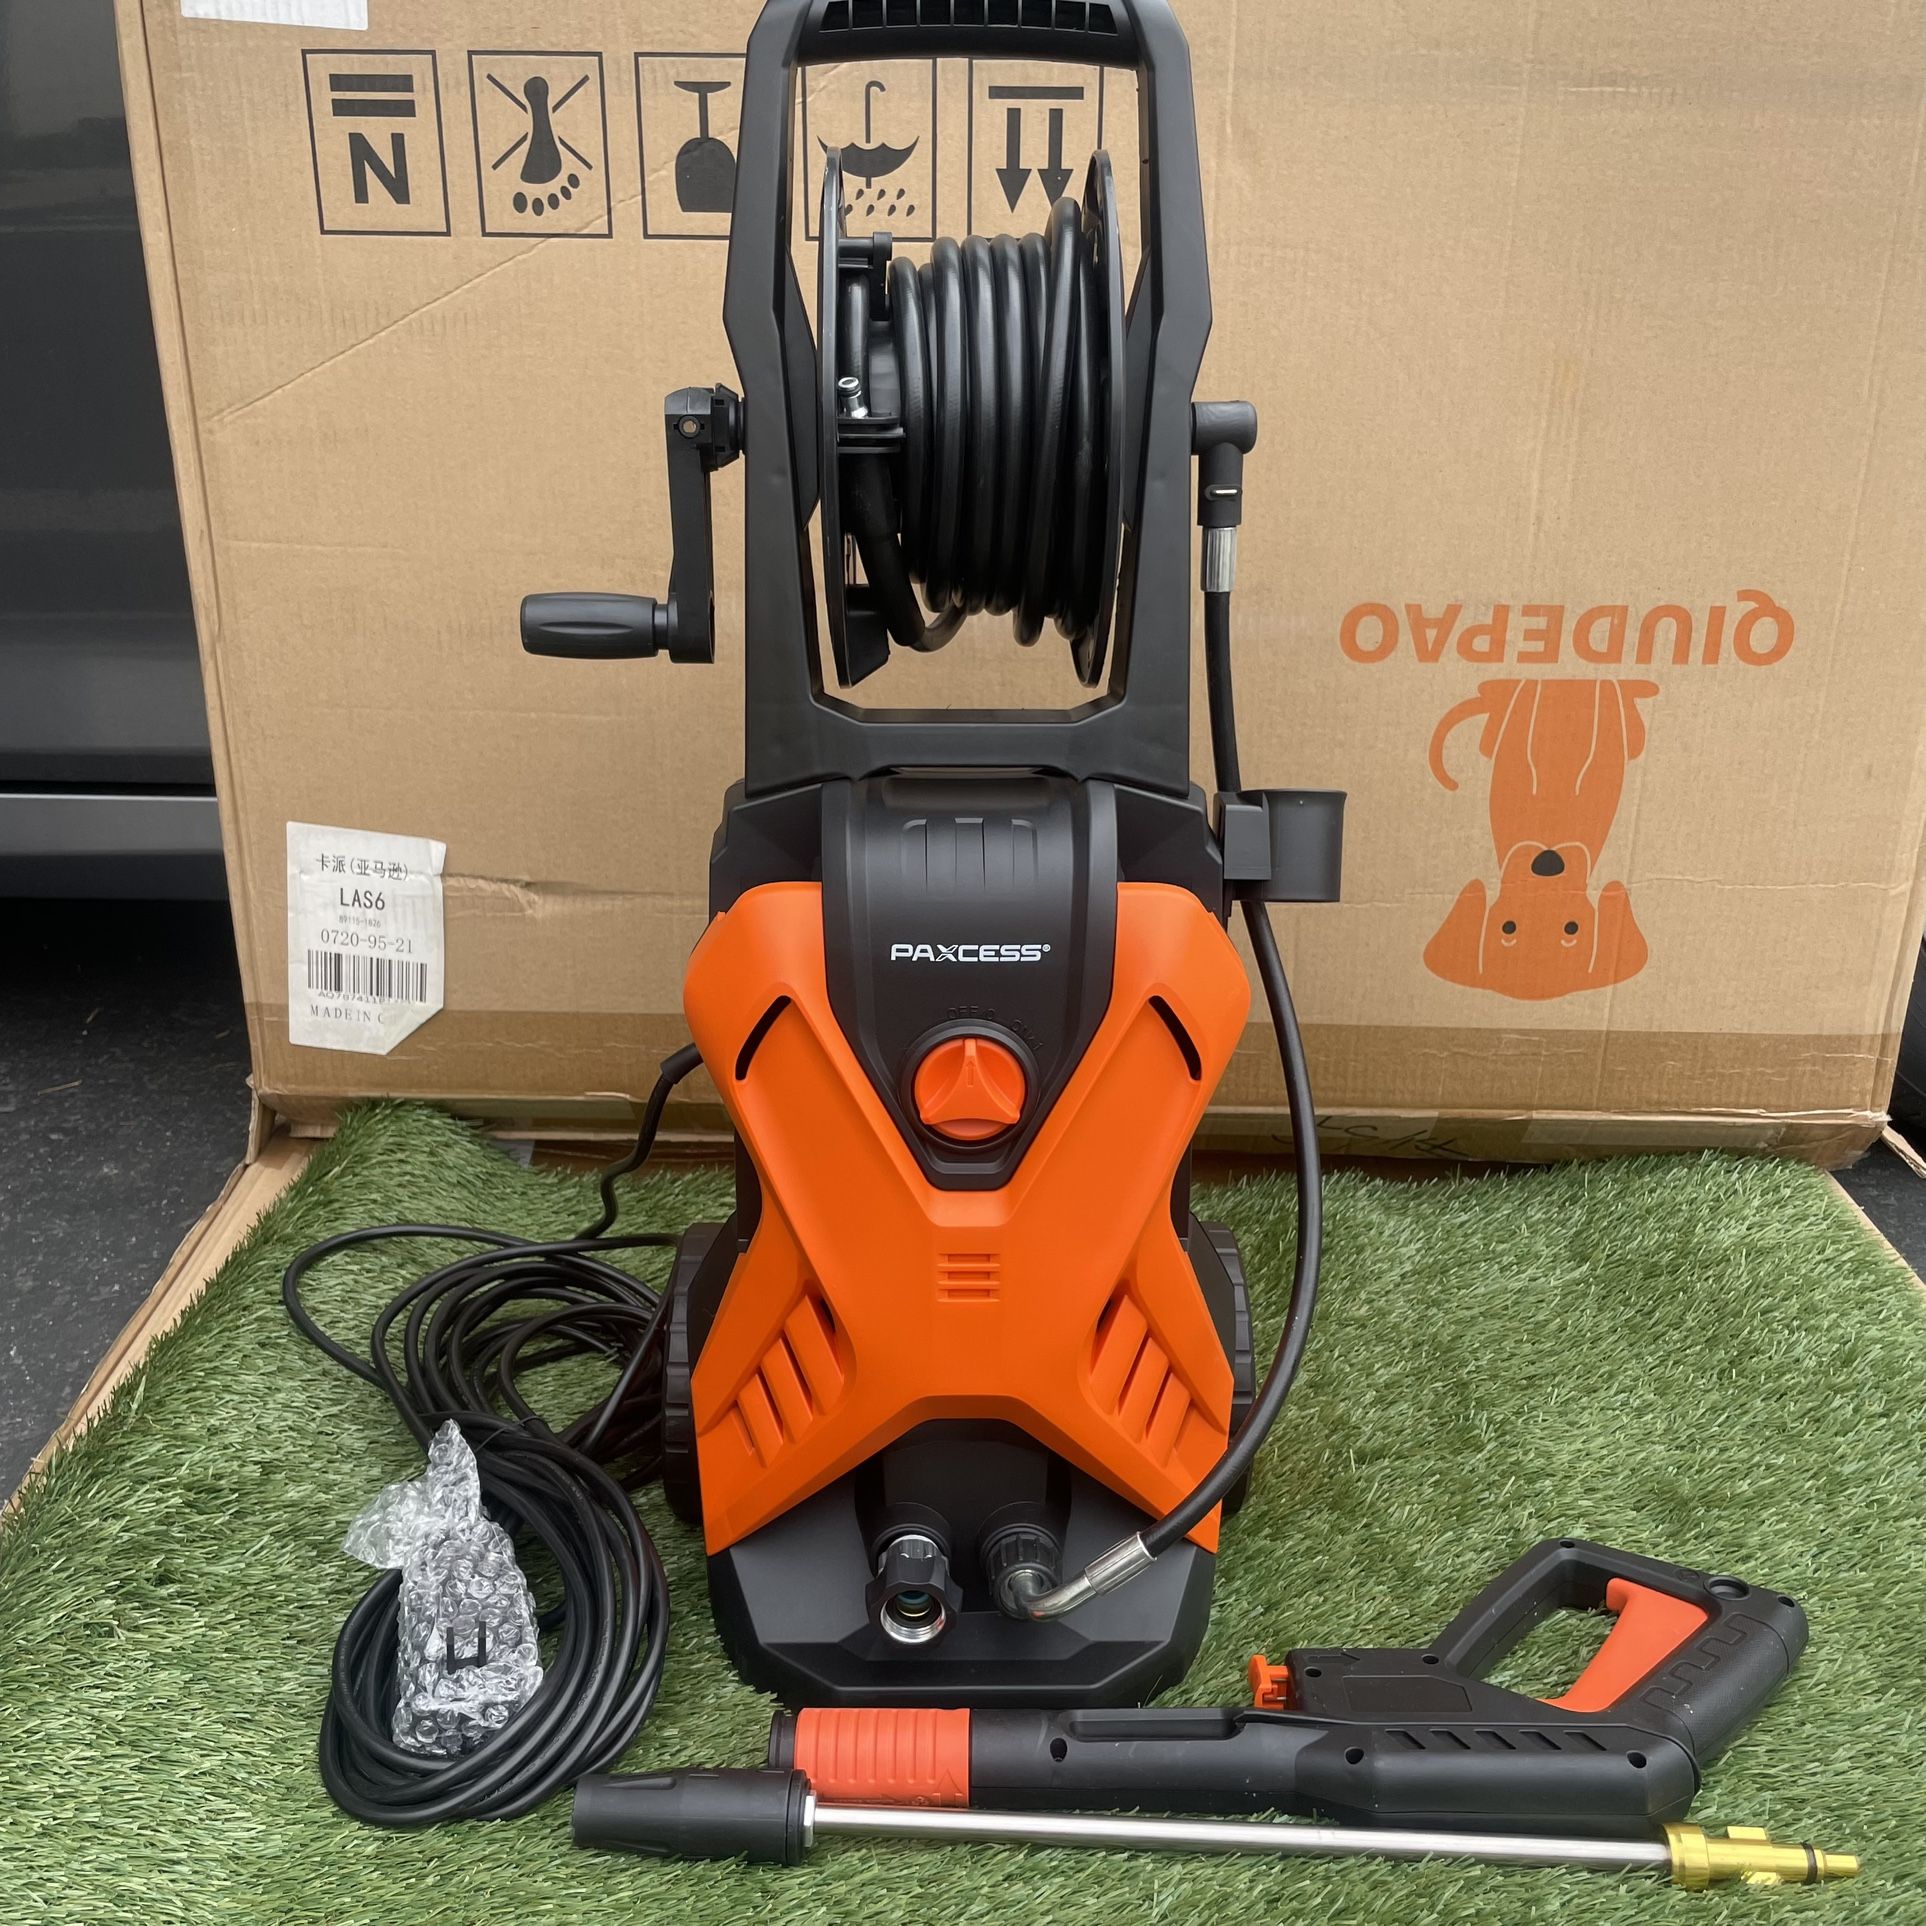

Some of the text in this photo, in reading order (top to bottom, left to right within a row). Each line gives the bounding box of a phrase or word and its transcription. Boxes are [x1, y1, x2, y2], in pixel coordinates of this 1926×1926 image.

[1339, 589, 1795, 666] QIUDEPAO
[340, 887, 386, 911] LAS6
[321, 928, 413, 954] 0720-95-21
[311, 1004, 352, 1021] MADE
